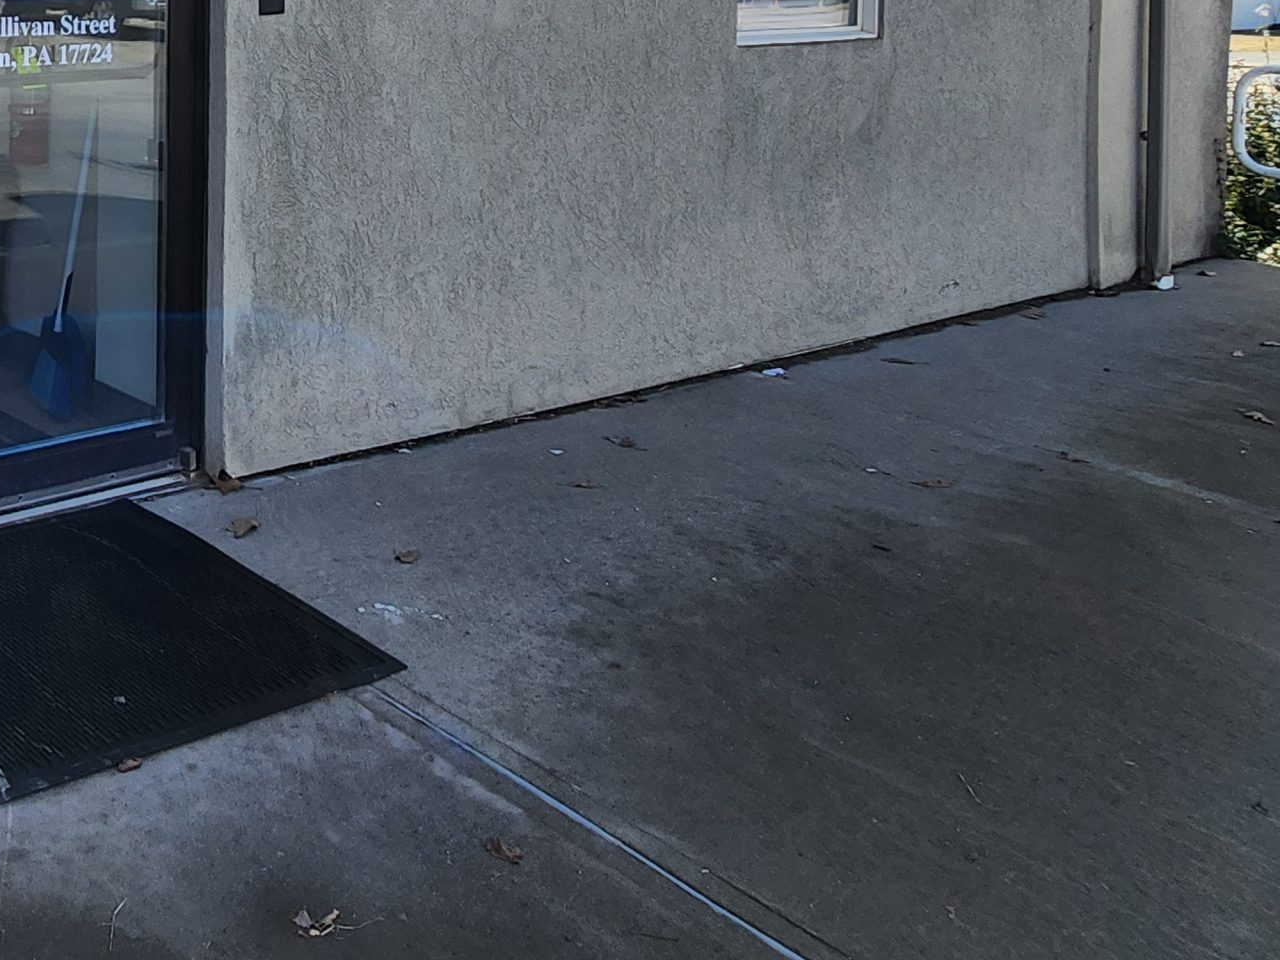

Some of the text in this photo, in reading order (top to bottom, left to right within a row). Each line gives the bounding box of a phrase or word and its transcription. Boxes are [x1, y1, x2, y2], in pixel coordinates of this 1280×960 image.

[60, 14, 117, 36] Street
[23, 46, 53, 67] PA
[58, 42, 114, 66] 17724
